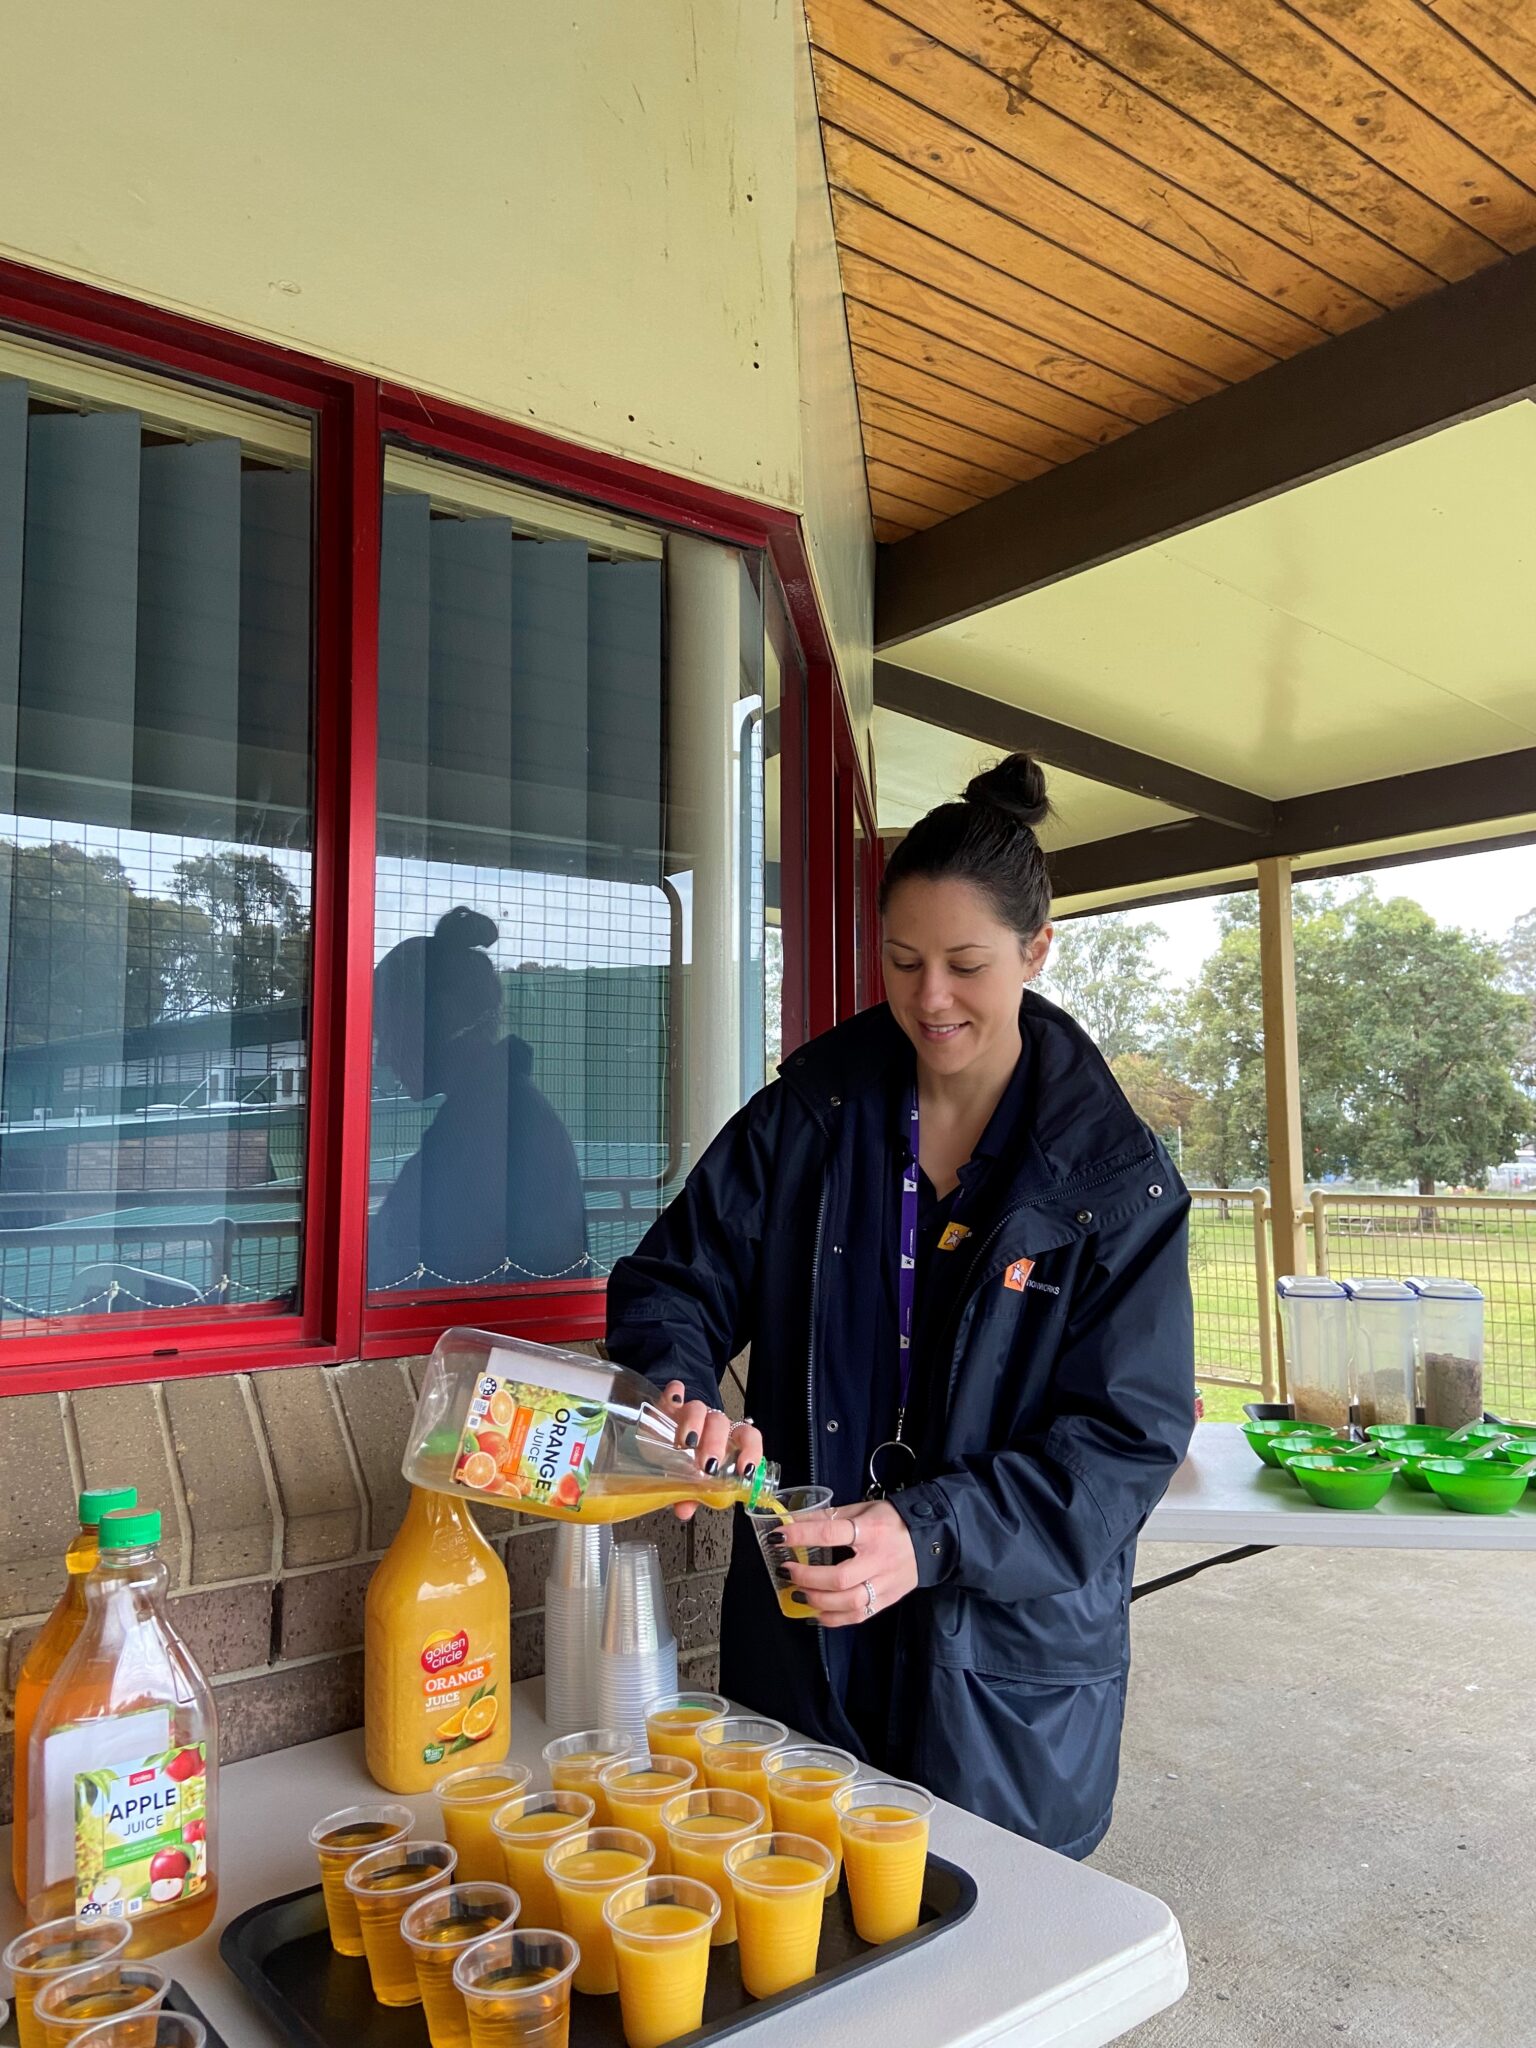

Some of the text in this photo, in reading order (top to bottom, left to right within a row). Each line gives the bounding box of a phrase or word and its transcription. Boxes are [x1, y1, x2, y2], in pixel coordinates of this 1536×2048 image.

[528, 1427, 545, 1463] JUICE
[535, 1408, 570, 1491] ORANGE
[425, 1638, 466, 1663] golden
[431, 1649, 462, 1668] circle
[425, 1666, 485, 1692] ORANGE
[425, 1691, 460, 1708] JUICE
[109, 1787, 176, 1824] APPLE
[123, 1815, 164, 1837] JUICE
